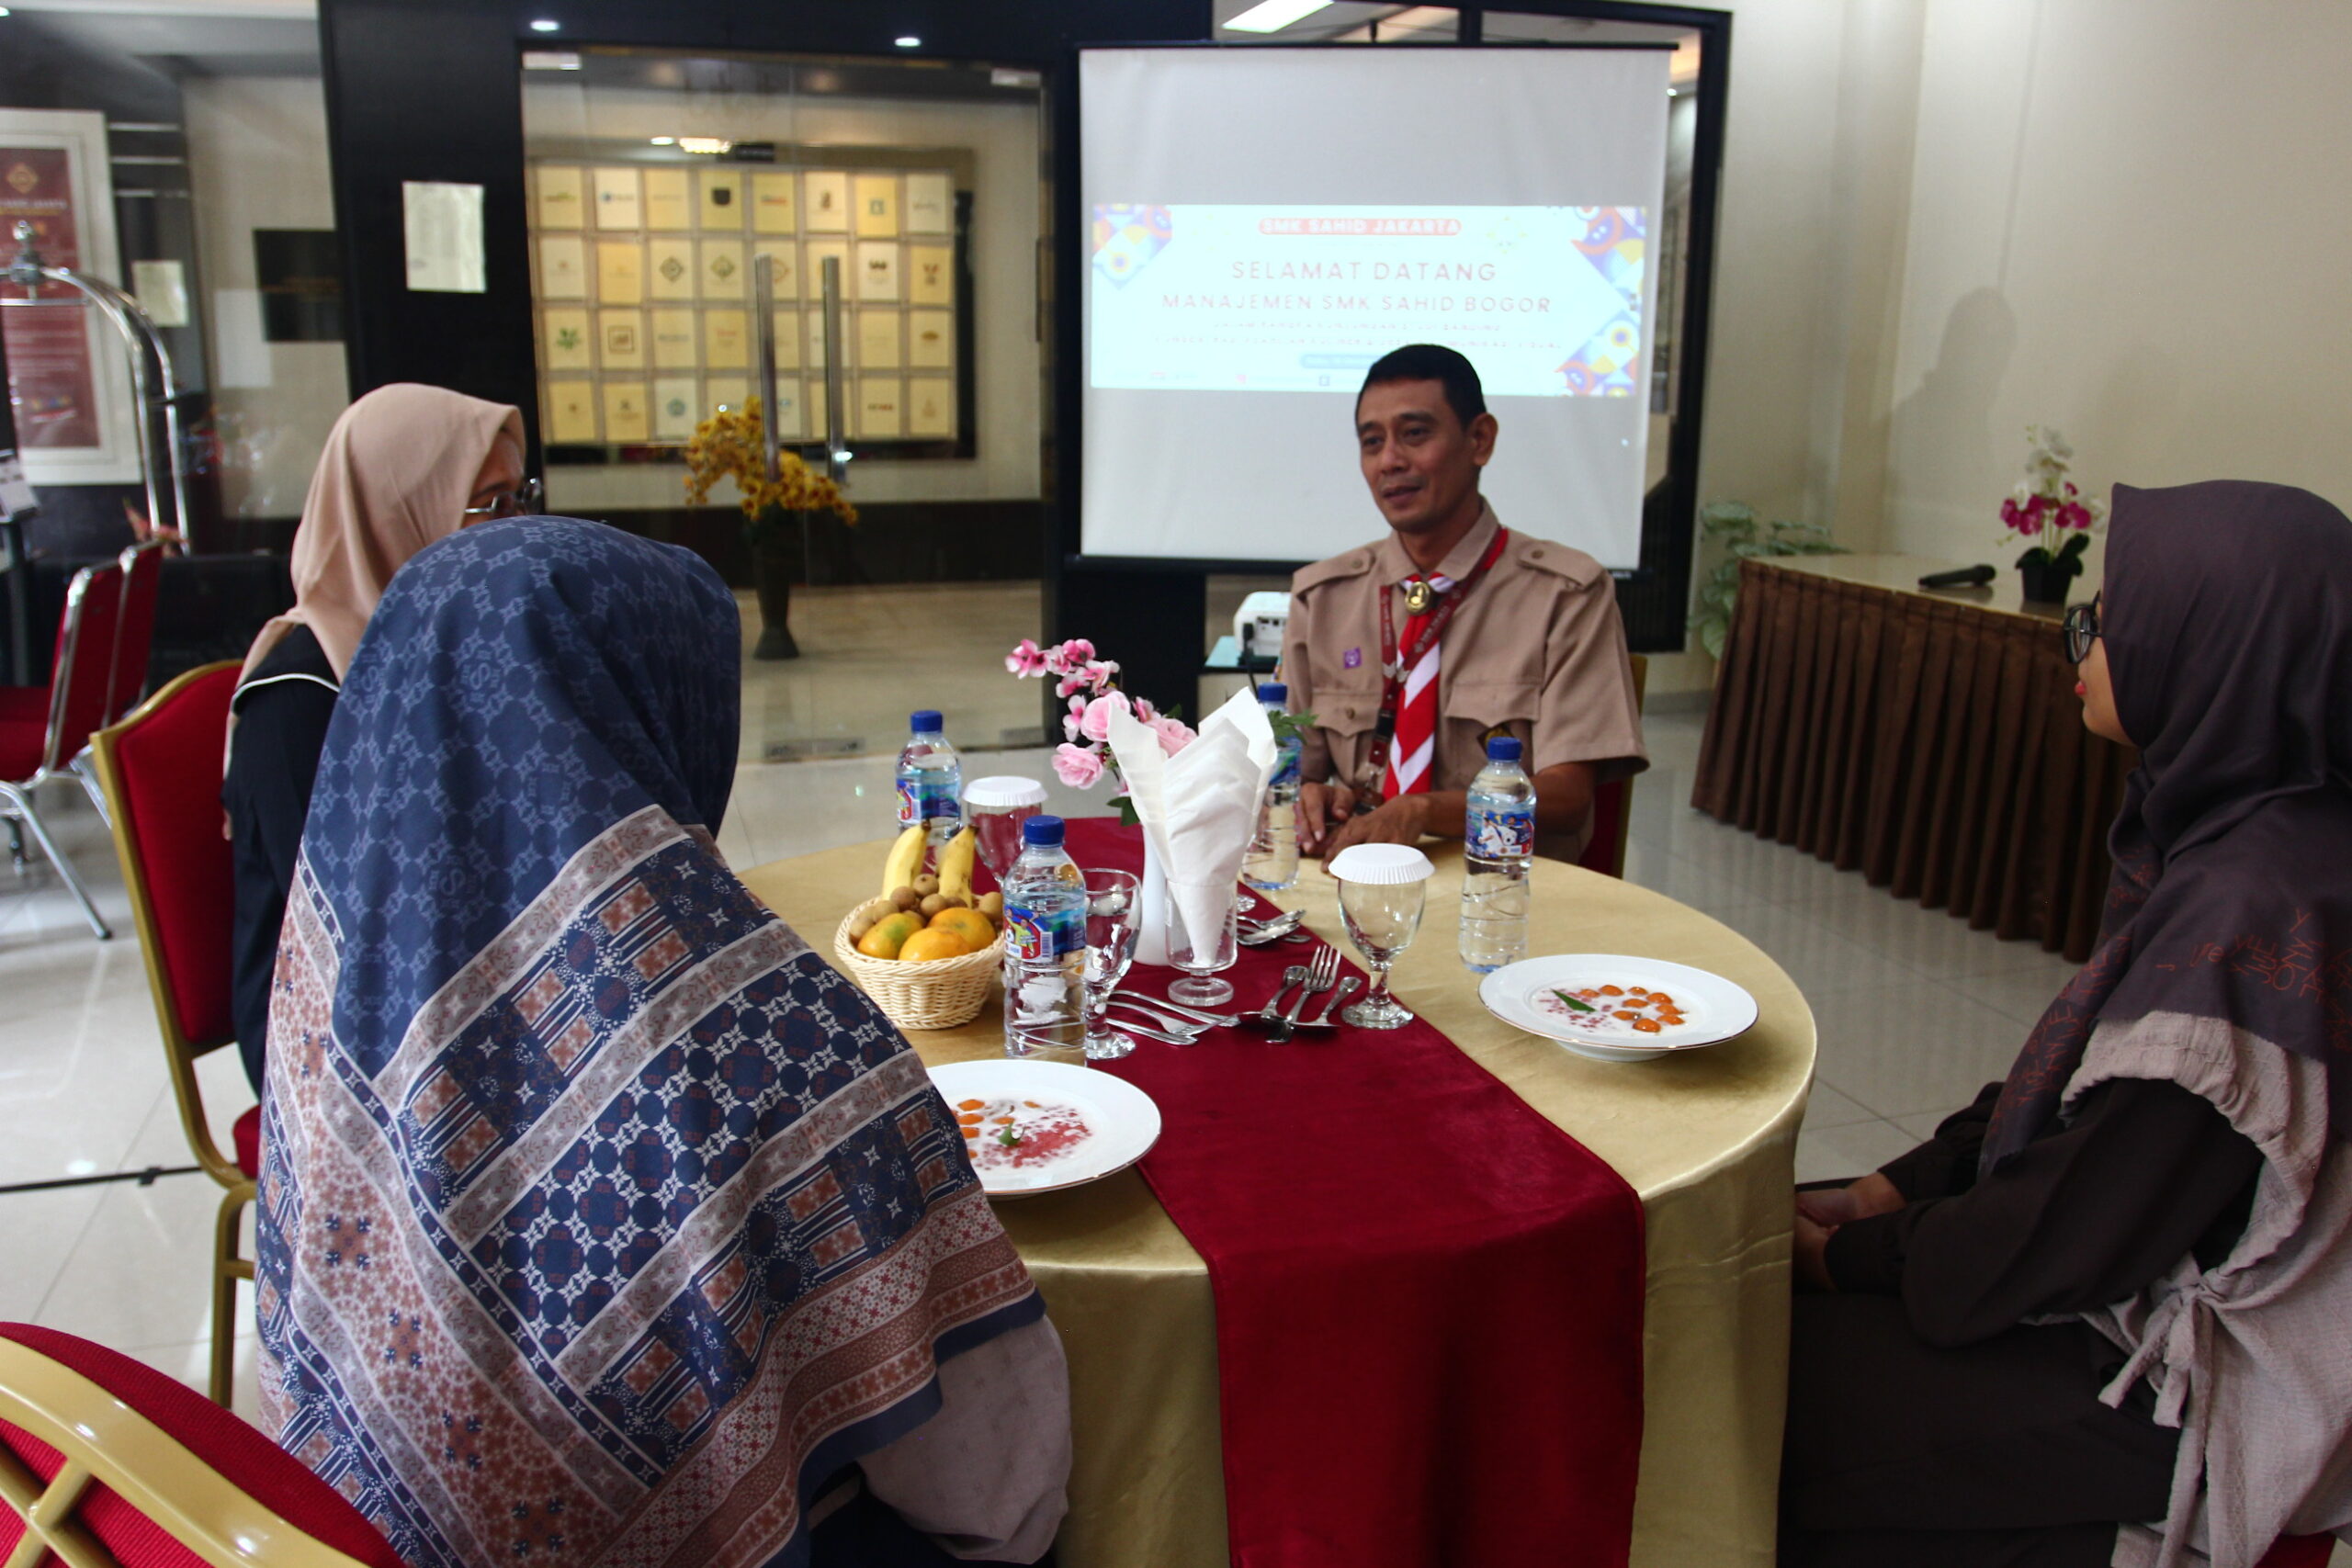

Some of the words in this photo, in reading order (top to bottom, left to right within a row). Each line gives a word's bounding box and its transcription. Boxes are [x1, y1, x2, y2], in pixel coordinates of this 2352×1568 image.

[1262, 220, 1302, 232] SMK
[1308, 220, 1367, 232] SAHID
[1374, 220, 1459, 233] JAKARTA
[1232, 261, 1362, 280] SELAMAT
[1374, 262, 1497, 282] DATANG
[1162, 293, 1312, 310] MANAJEMEN
[1322, 294, 1370, 311] SMK
[1383, 295, 1453, 312] SAHID
[1464, 296, 1551, 314] BOGOR
